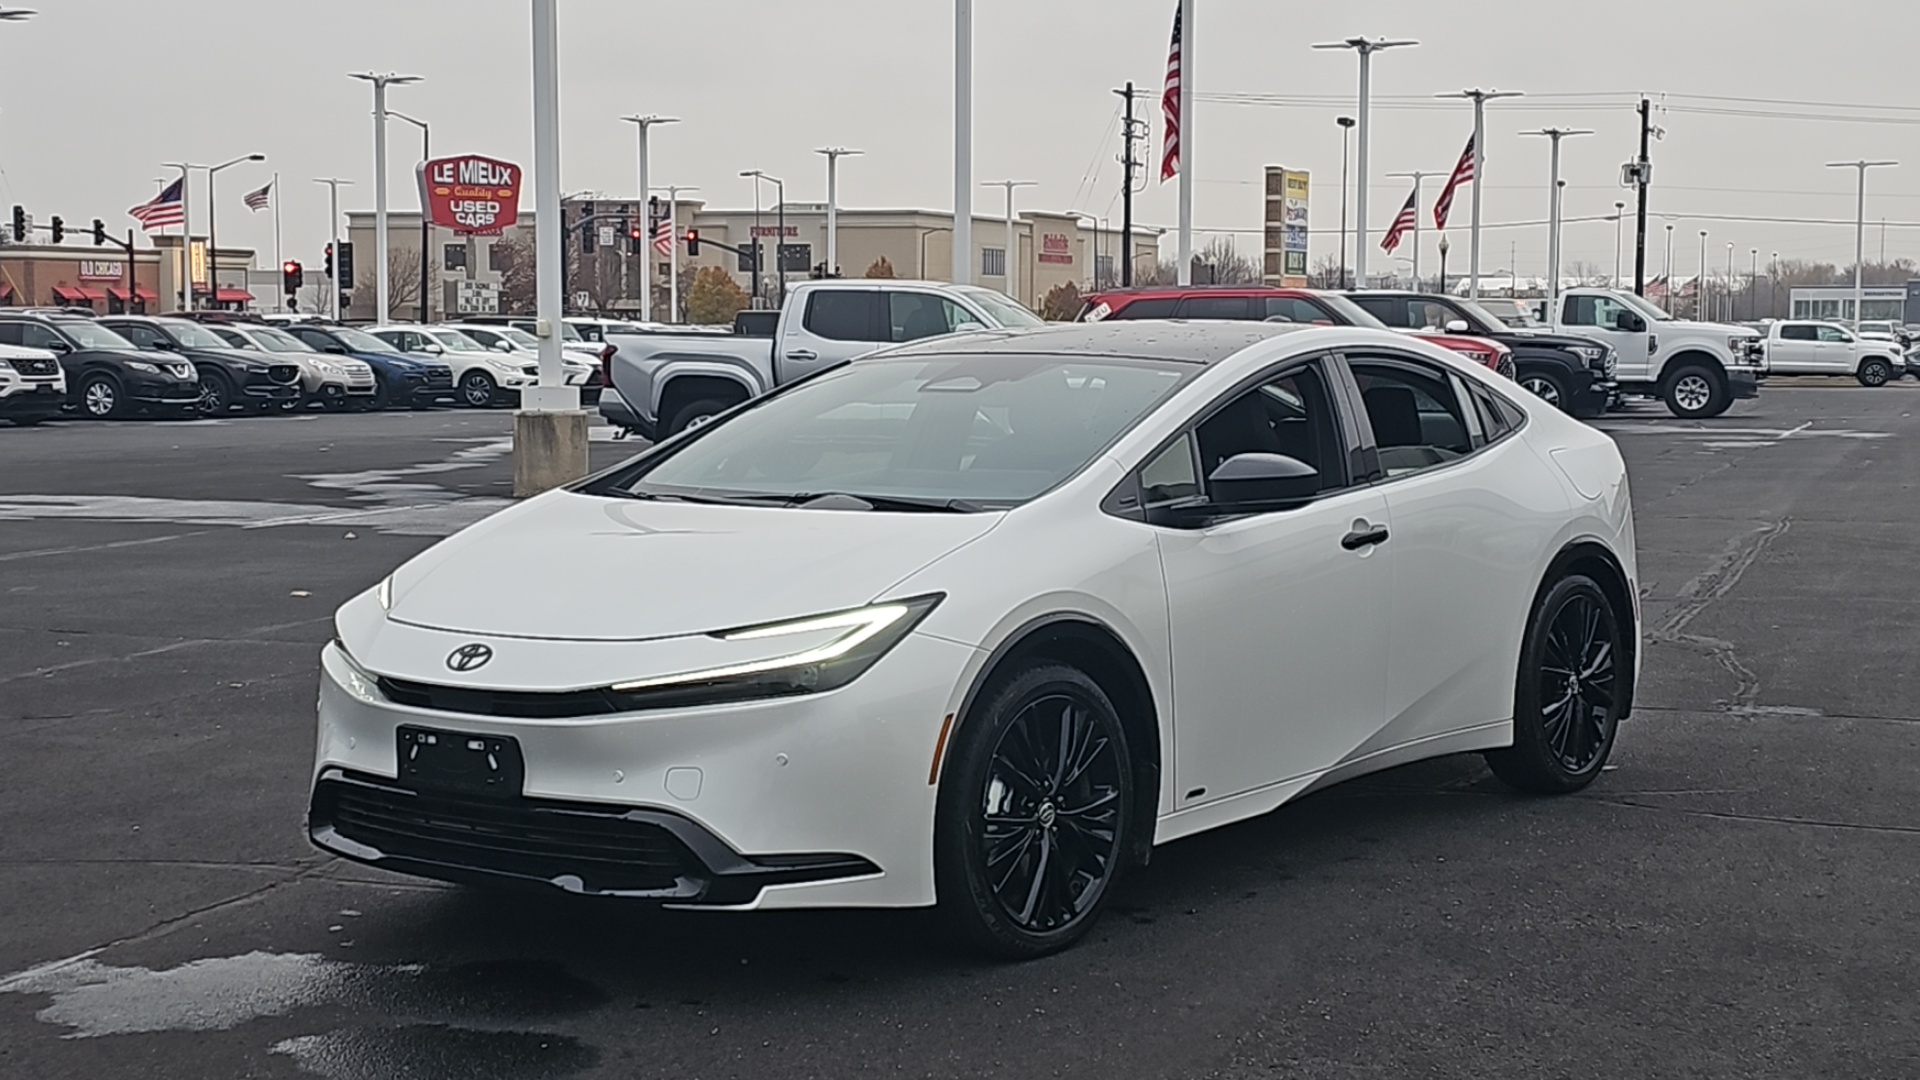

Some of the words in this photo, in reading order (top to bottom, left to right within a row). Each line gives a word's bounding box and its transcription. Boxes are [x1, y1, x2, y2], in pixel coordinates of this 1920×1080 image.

[433, 163, 454, 183] LE
[459, 160, 512, 185] MIEUX
[454, 186, 492, 200] Quality
[450, 199, 500, 214] USED
[455, 213, 496, 228] CARS
[750, 226, 799, 237] FURNITURE
[81, 260, 94, 276] OLD
[95, 260, 123, 276] CHICAGO
